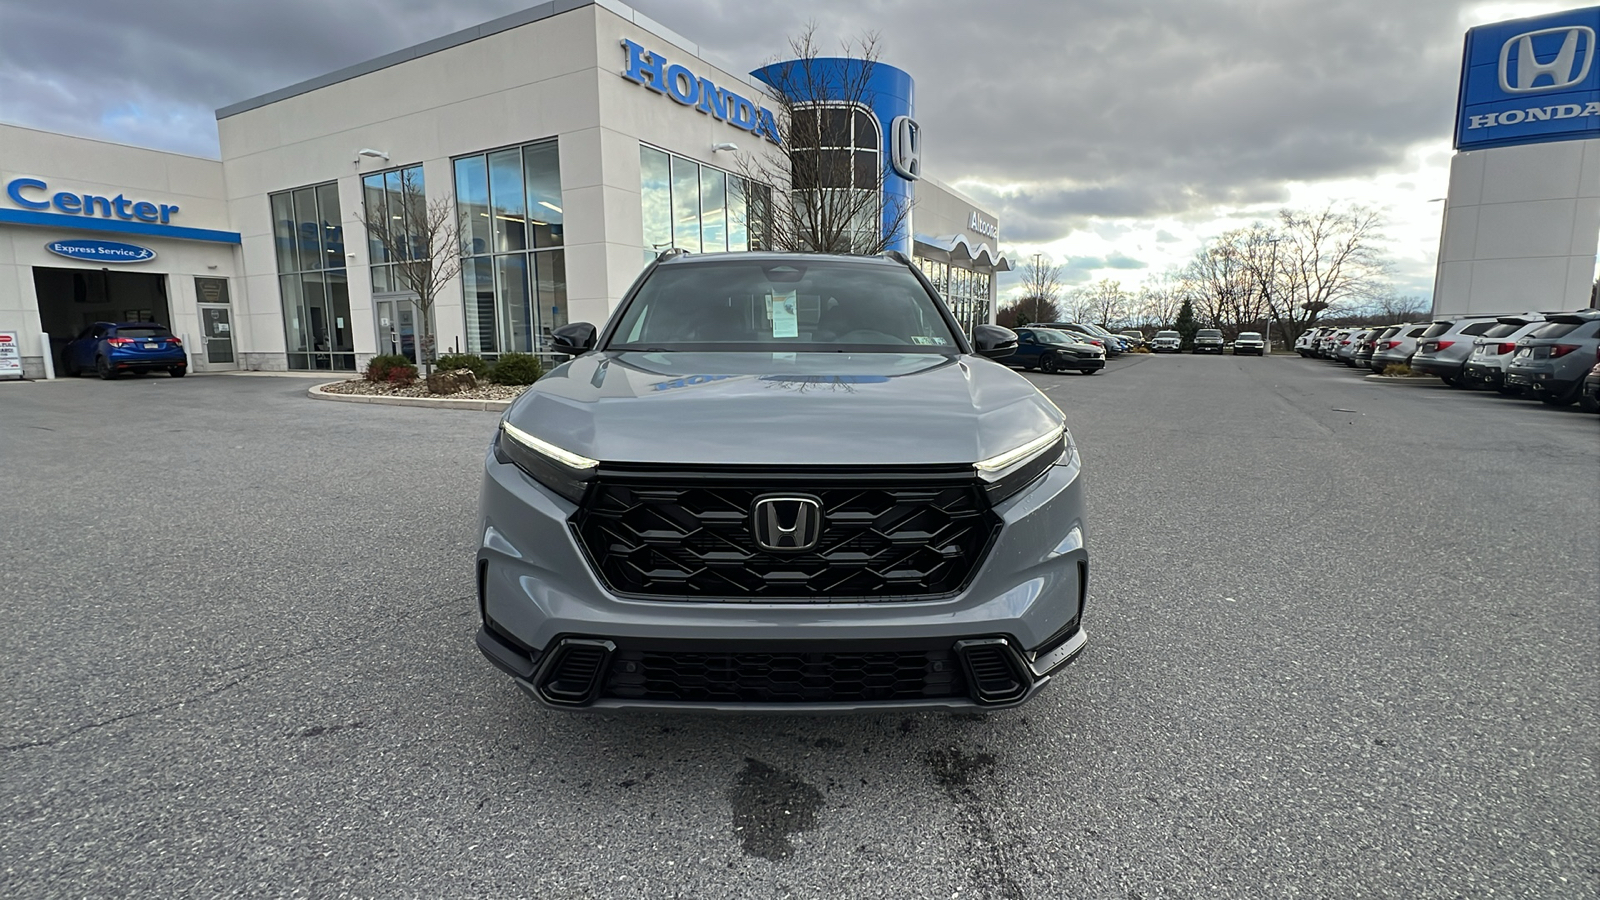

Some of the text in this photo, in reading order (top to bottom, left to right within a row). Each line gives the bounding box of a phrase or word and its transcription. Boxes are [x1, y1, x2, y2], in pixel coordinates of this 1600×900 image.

[620, 38, 782, 145] HONDA
[1468, 101, 1600, 129] HONDA
[7, 178, 179, 223] Center
[54, 243, 135, 256] Express Service
